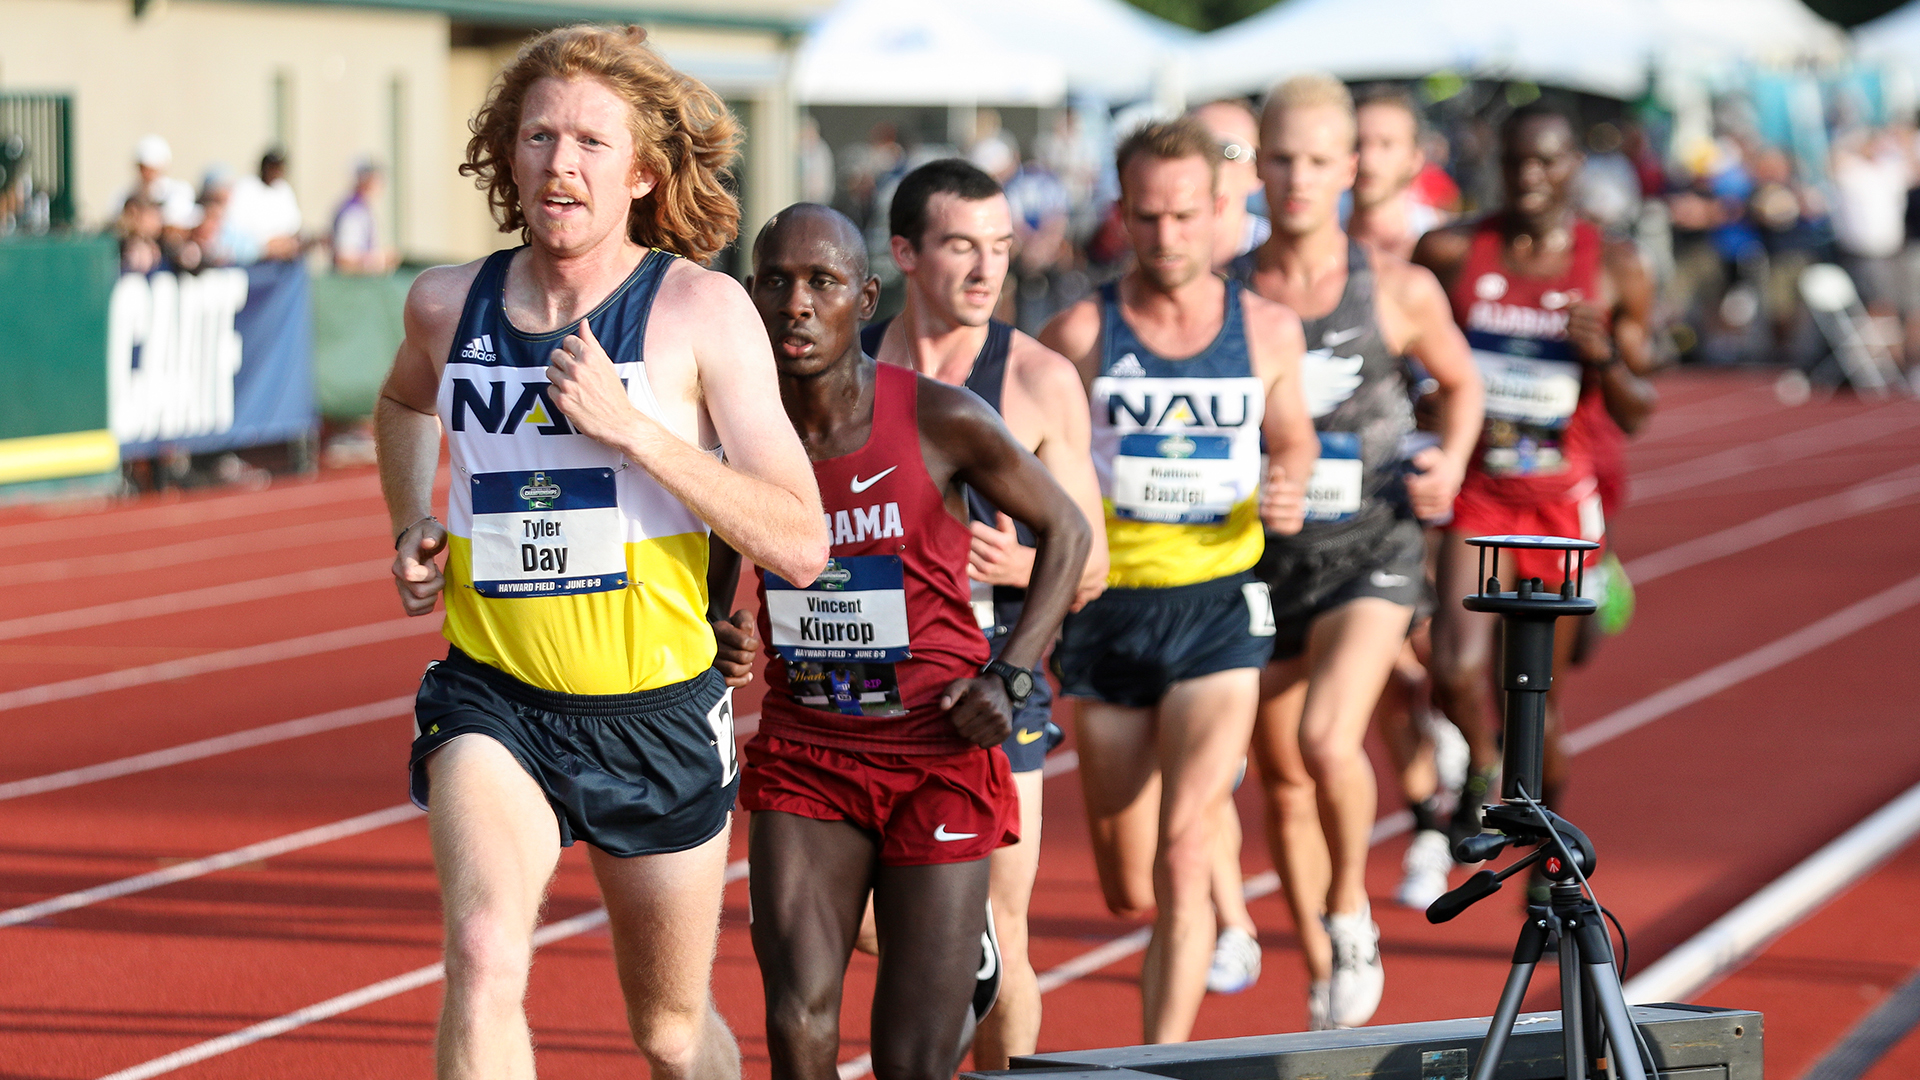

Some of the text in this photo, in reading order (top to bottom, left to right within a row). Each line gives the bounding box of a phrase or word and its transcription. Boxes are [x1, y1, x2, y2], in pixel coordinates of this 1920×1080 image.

[461, 349, 497, 362] adidas
[452, 378, 629, 435] NA
[1109, 394, 1249, 427] NAU
[522, 519, 562, 540] Tyler
[521, 543, 569, 575] Day
[498, 578, 602, 593] HAYWARD FIELD JUNE 6-9
[806, 596, 863, 614] Vincent
[799, 616, 875, 645] Kiprop
[795, 648, 887, 658] HAYWARD FIELD JUNE 6-9
[863, 678, 882, 689] RIP
